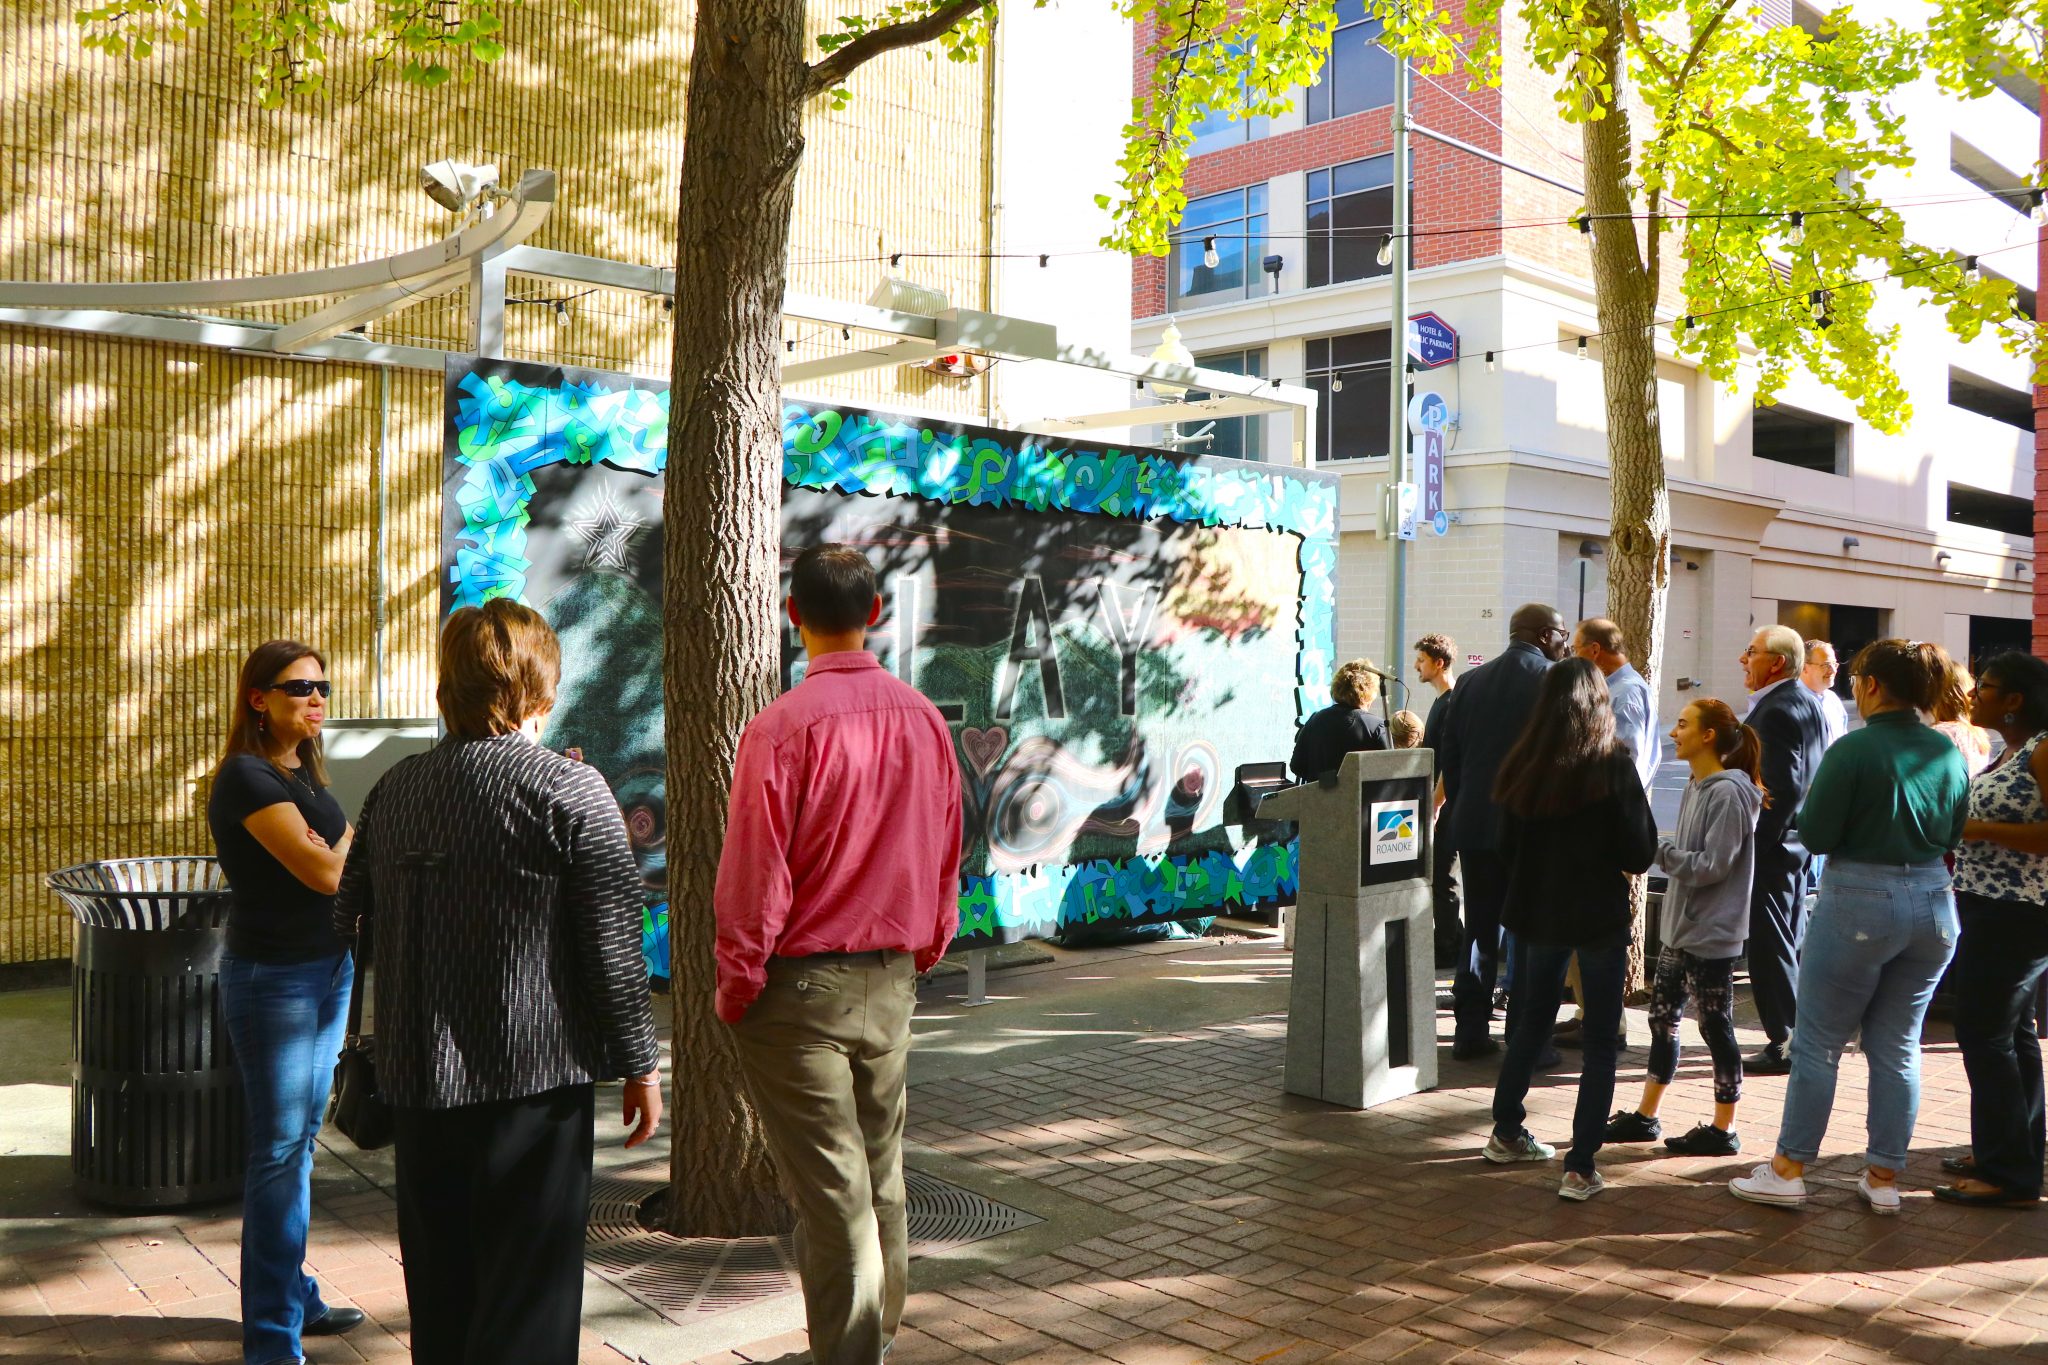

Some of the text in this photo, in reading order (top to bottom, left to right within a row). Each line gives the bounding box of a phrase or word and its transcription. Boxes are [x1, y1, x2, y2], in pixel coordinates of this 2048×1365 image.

[1420, 325, 1437, 336] HOTEL
[1409, 333, 1452, 351] PUBLIC PARKING
[1428, 405, 1441, 511] PARK
[1481, 609, 1493, 618] 25
[781, 575, 1161, 721] LAY
[1376, 841, 1412, 854] ROANOKE
